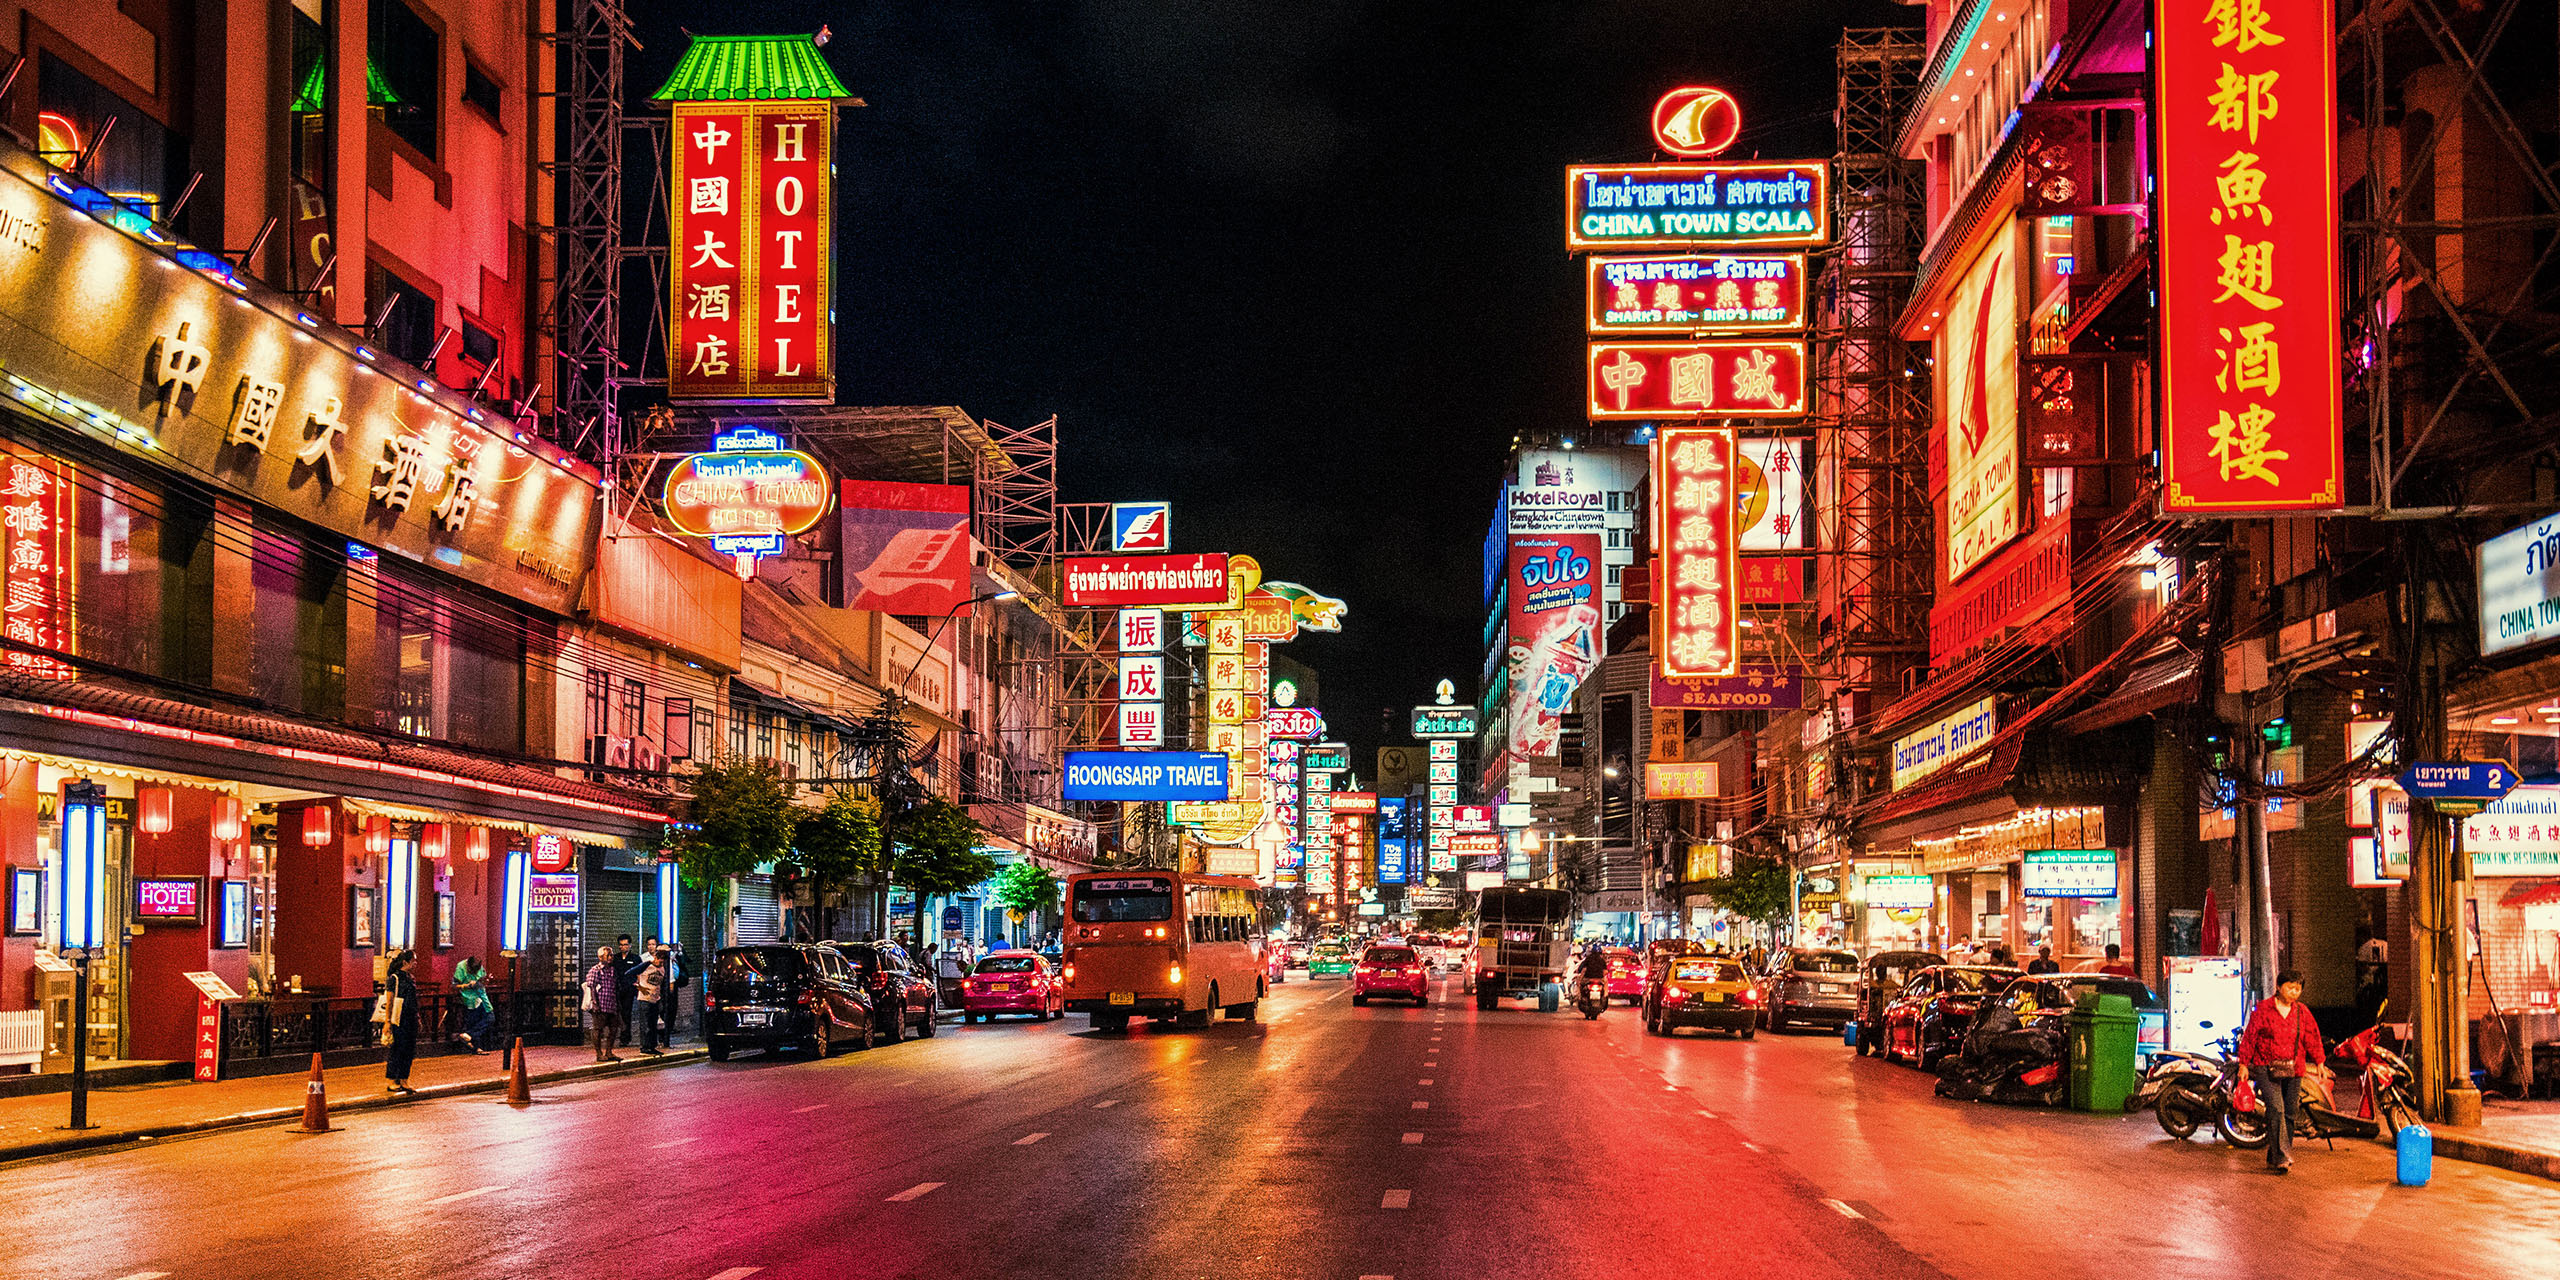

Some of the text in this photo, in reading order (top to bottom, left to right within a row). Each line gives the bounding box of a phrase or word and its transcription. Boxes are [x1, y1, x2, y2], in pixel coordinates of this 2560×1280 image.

[1583, 172, 1717, 208] ไชน่าทาวน์
[1582, 211, 1815, 236] CHINA TOWN SCALA
[687, 121, 735, 378] 中國大酒店
[773, 123, 807, 377] HOTEL
[2203, 0, 2290, 487] 銀都魚翅酒樓
[1703, 308, 1748, 321] BIRD'S
[1750, 308, 1787, 321] NEST
[1602, 349, 1785, 410] 中國城
[157, 322, 482, 532] 中國大酒店
[676, 480, 744, 506] CHINA
[754, 480, 821, 506] TOWN
[1952, 449, 2011, 526] CHINA TOWN
[1511, 490, 1603, 509] Hotel Royal
[710, 508, 782, 528] HOTEL
[1510, 510, 1605, 522] Bangkok Chinatown
[1952, 507, 2012, 575] SCALA
[1671, 438, 1727, 667] 銀都魚翅酒樓
[1521, 545, 1591, 587] จับใจ
[1068, 555, 1223, 602] รุ่งทรัพย์การท่องเที่ยว
[1572, 584, 1591, 599] 10
[1744, 587, 1774, 599] FIN
[2500, 605, 2535, 639] CHINA
[1742, 639, 1775, 651] EST
[1125, 616, 1157, 742] 振成豐
[1682, 692, 1772, 705] SEAFOOD
[1661, 709, 1678, 757] 酒樓
[1068, 765, 1223, 786] ROONGSARP TRAVEL
[2415, 766, 2470, 781] เยาวราช
[2488, 768, 2502, 789] 2
[2388, 824, 2402, 842] 中
[537, 843, 560, 854] ZEN
[2513, 852, 2560, 866] RESTAURAN
[533, 887, 575, 895] CHINATOWN
[1114, 881, 1129, 889] 40
[1151, 885, 1171, 893] 40-3
[141, 889, 196, 905] HOTEL
[534, 895, 576, 907] HOTEL
